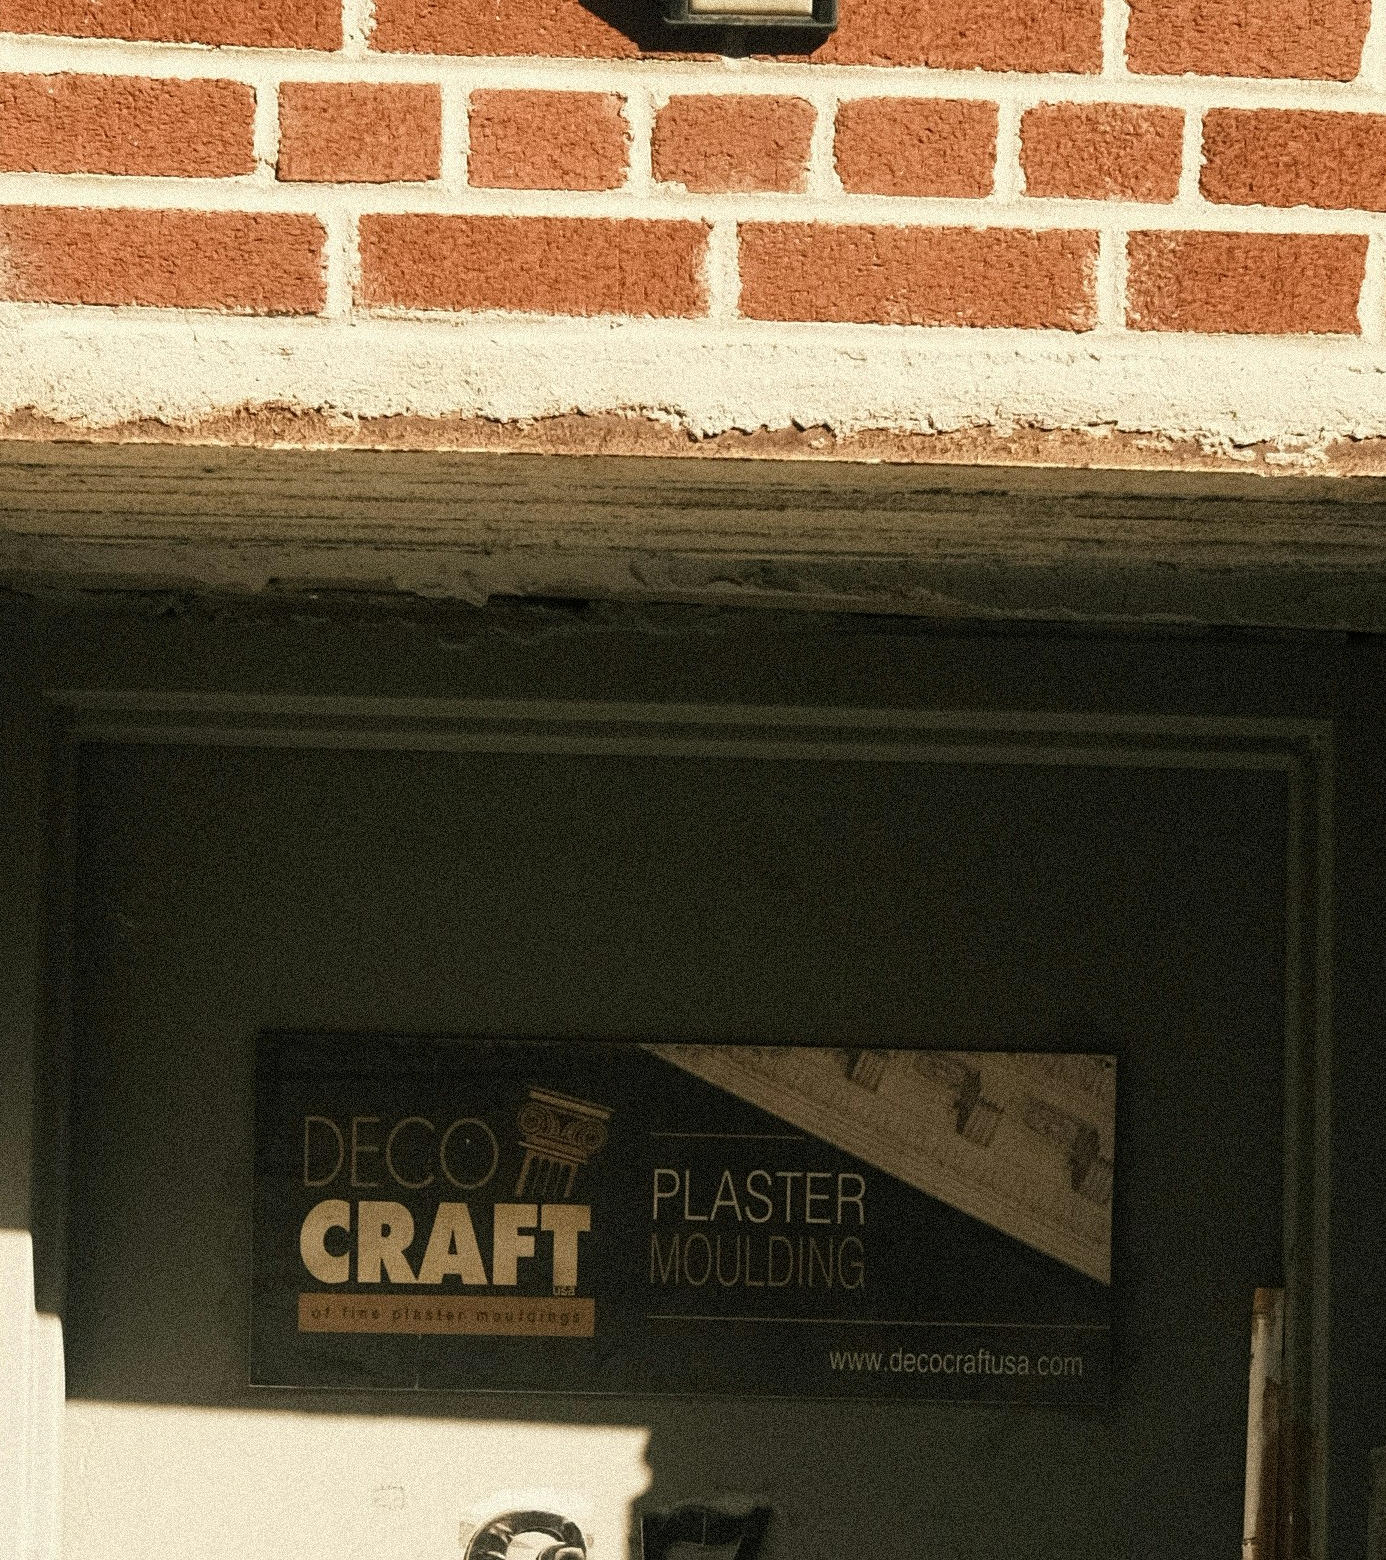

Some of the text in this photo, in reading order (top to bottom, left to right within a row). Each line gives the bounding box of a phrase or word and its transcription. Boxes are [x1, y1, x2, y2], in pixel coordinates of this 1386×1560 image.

[302, 1115, 500, 1190] DECO
[651, 1168, 867, 1225] PLASTER
[298, 1199, 592, 1287] CRAFT
[649, 1233, 867, 1290] MOULDING
[311, 1305, 583, 1327] of fine plaster mouldings
[828, 1347, 1085, 1377] www.decocraftusa.com
